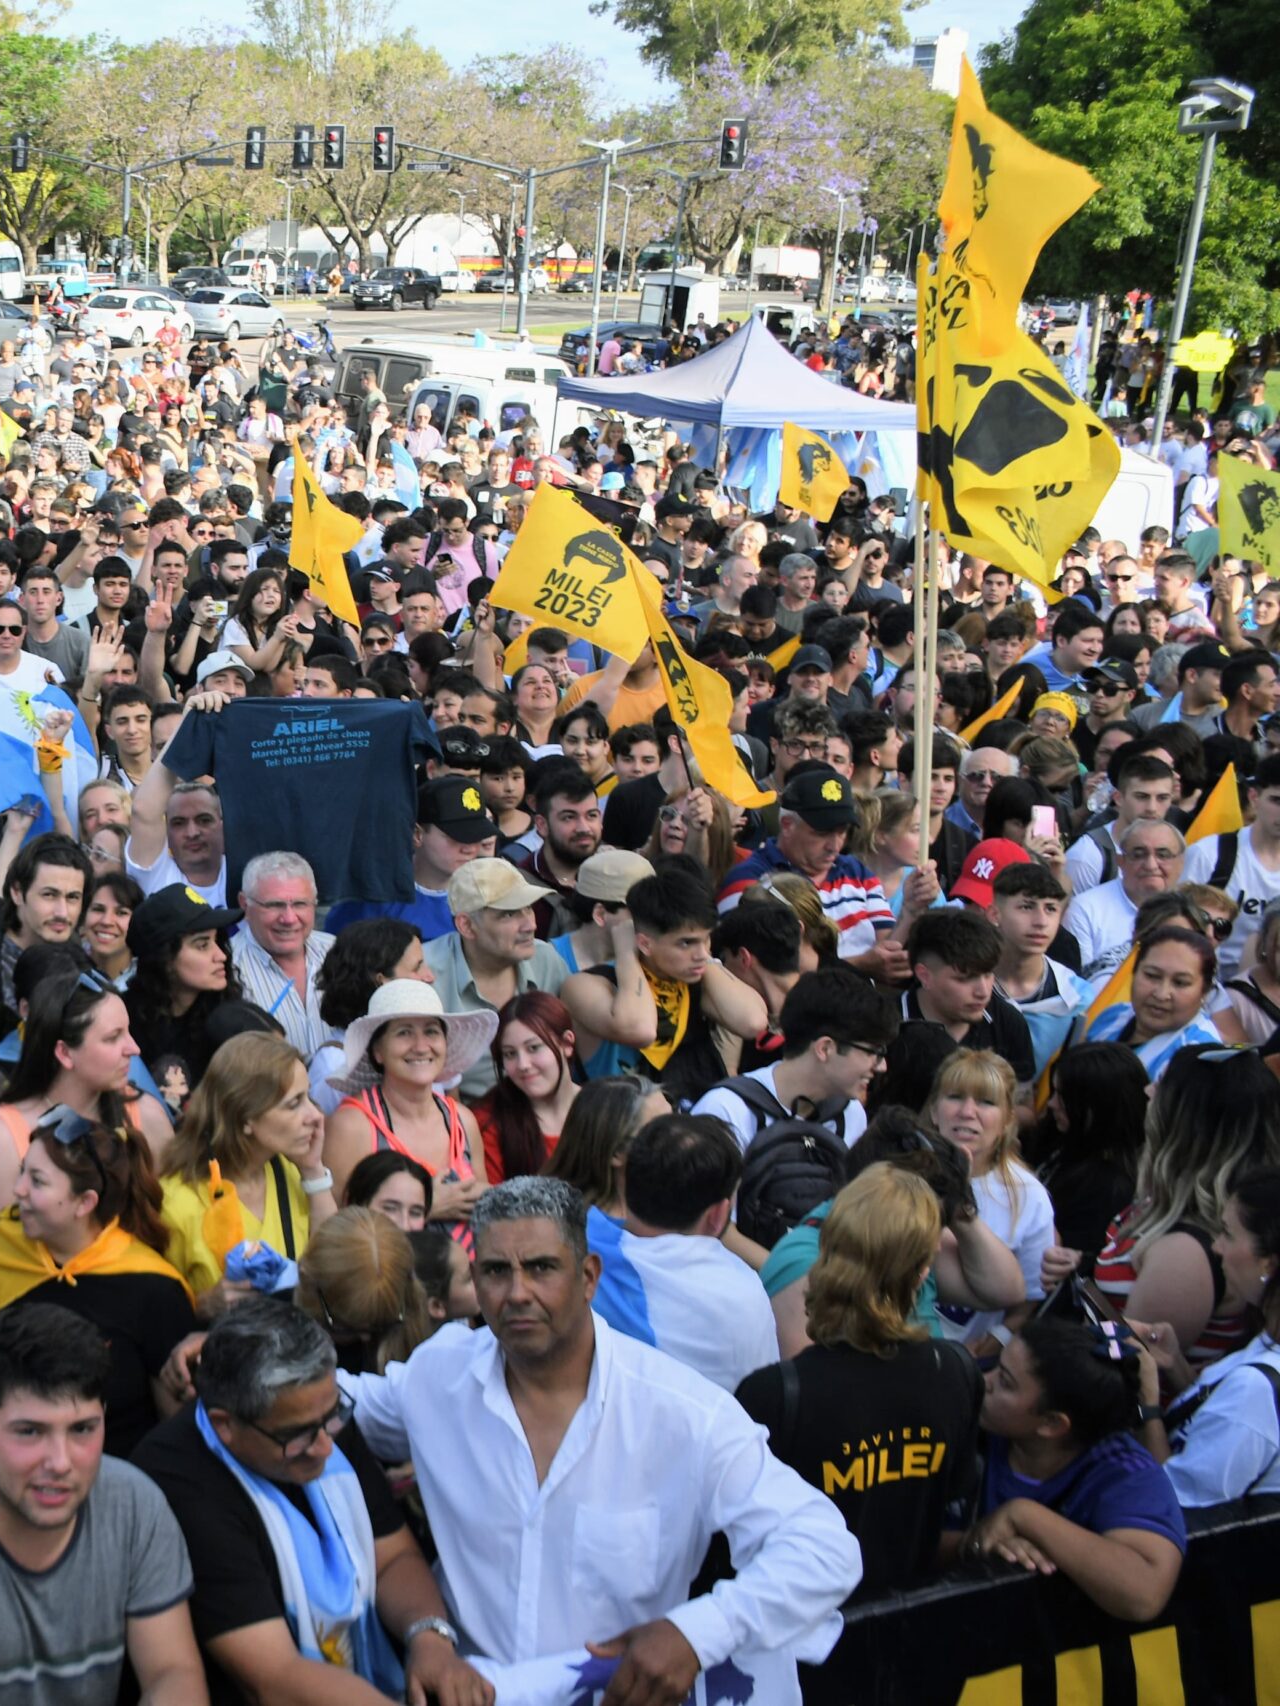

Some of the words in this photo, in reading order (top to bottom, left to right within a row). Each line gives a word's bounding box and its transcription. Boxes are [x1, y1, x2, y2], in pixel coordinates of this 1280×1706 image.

[587, 541, 598, 551] LA
[544, 567, 612, 609] MILEI
[534, 587, 602, 628] 2023
[273, 718, 345, 737] ARIEL
[327, 731, 339, 739] de
[341, 730, 371, 739] chapa
[252, 748, 288, 760] Marcelo
[300, 744, 312, 754] de
[314, 742, 344, 753] Alvear
[842, 1426, 931, 1456] JAVIER
[822, 1442, 946, 1496] MILEI
